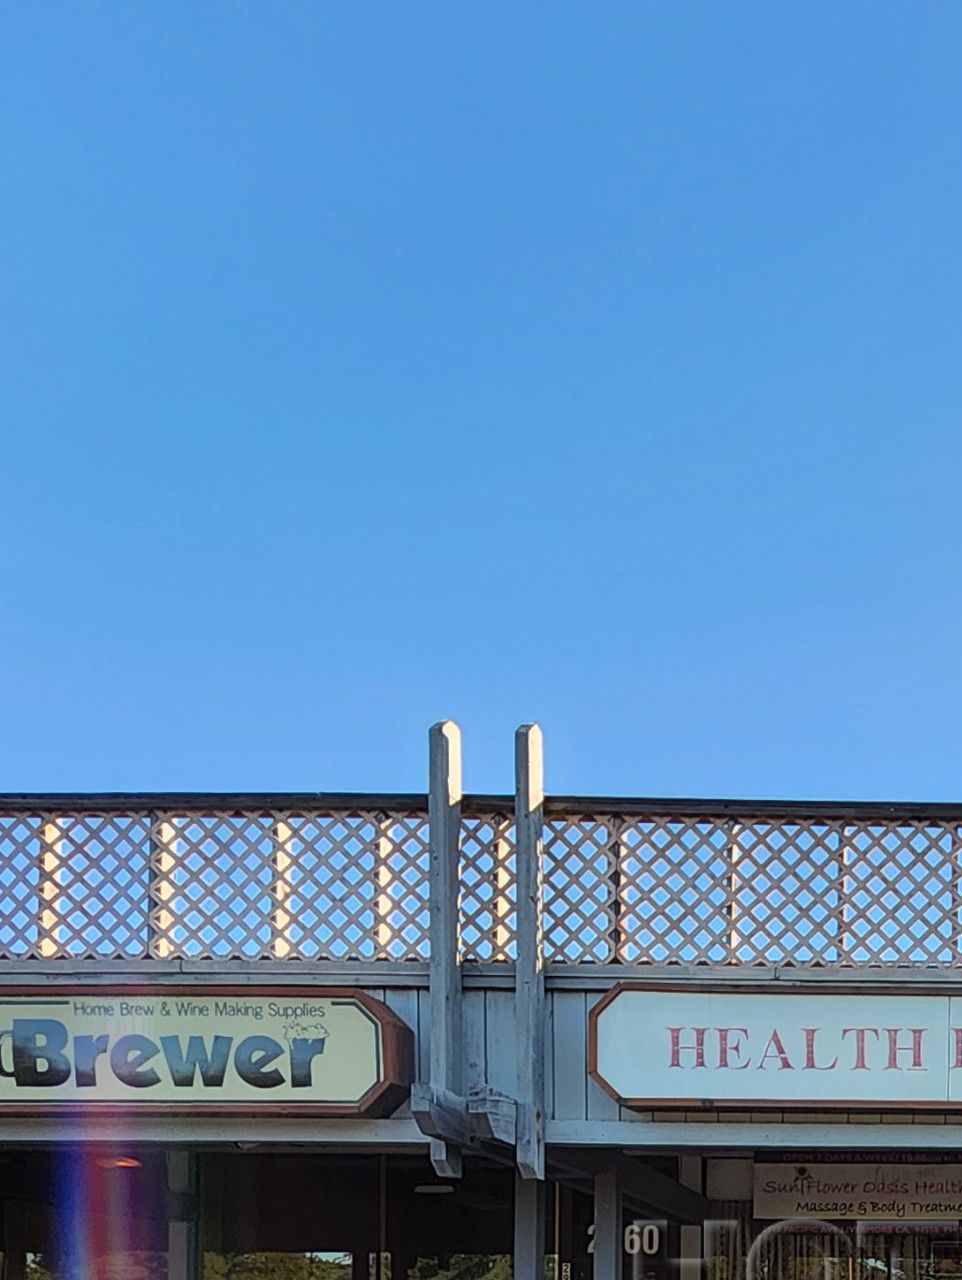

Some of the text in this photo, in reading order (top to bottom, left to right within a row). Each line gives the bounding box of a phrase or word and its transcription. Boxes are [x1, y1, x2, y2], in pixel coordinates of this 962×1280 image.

[74, 1002, 326, 1020] Home Brew & Wine Making Supplies
[13, 1018, 327, 1088] Brewer
[667, 1026, 928, 1072] HEALTH
[863, 1179, 908, 1195] Oasis
[796, 1200, 854, 1217] Massage
[856, 1201, 866, 1215] &
[871, 1200, 907, 1219] Body
[587, 1223, 660, 1256] 260
